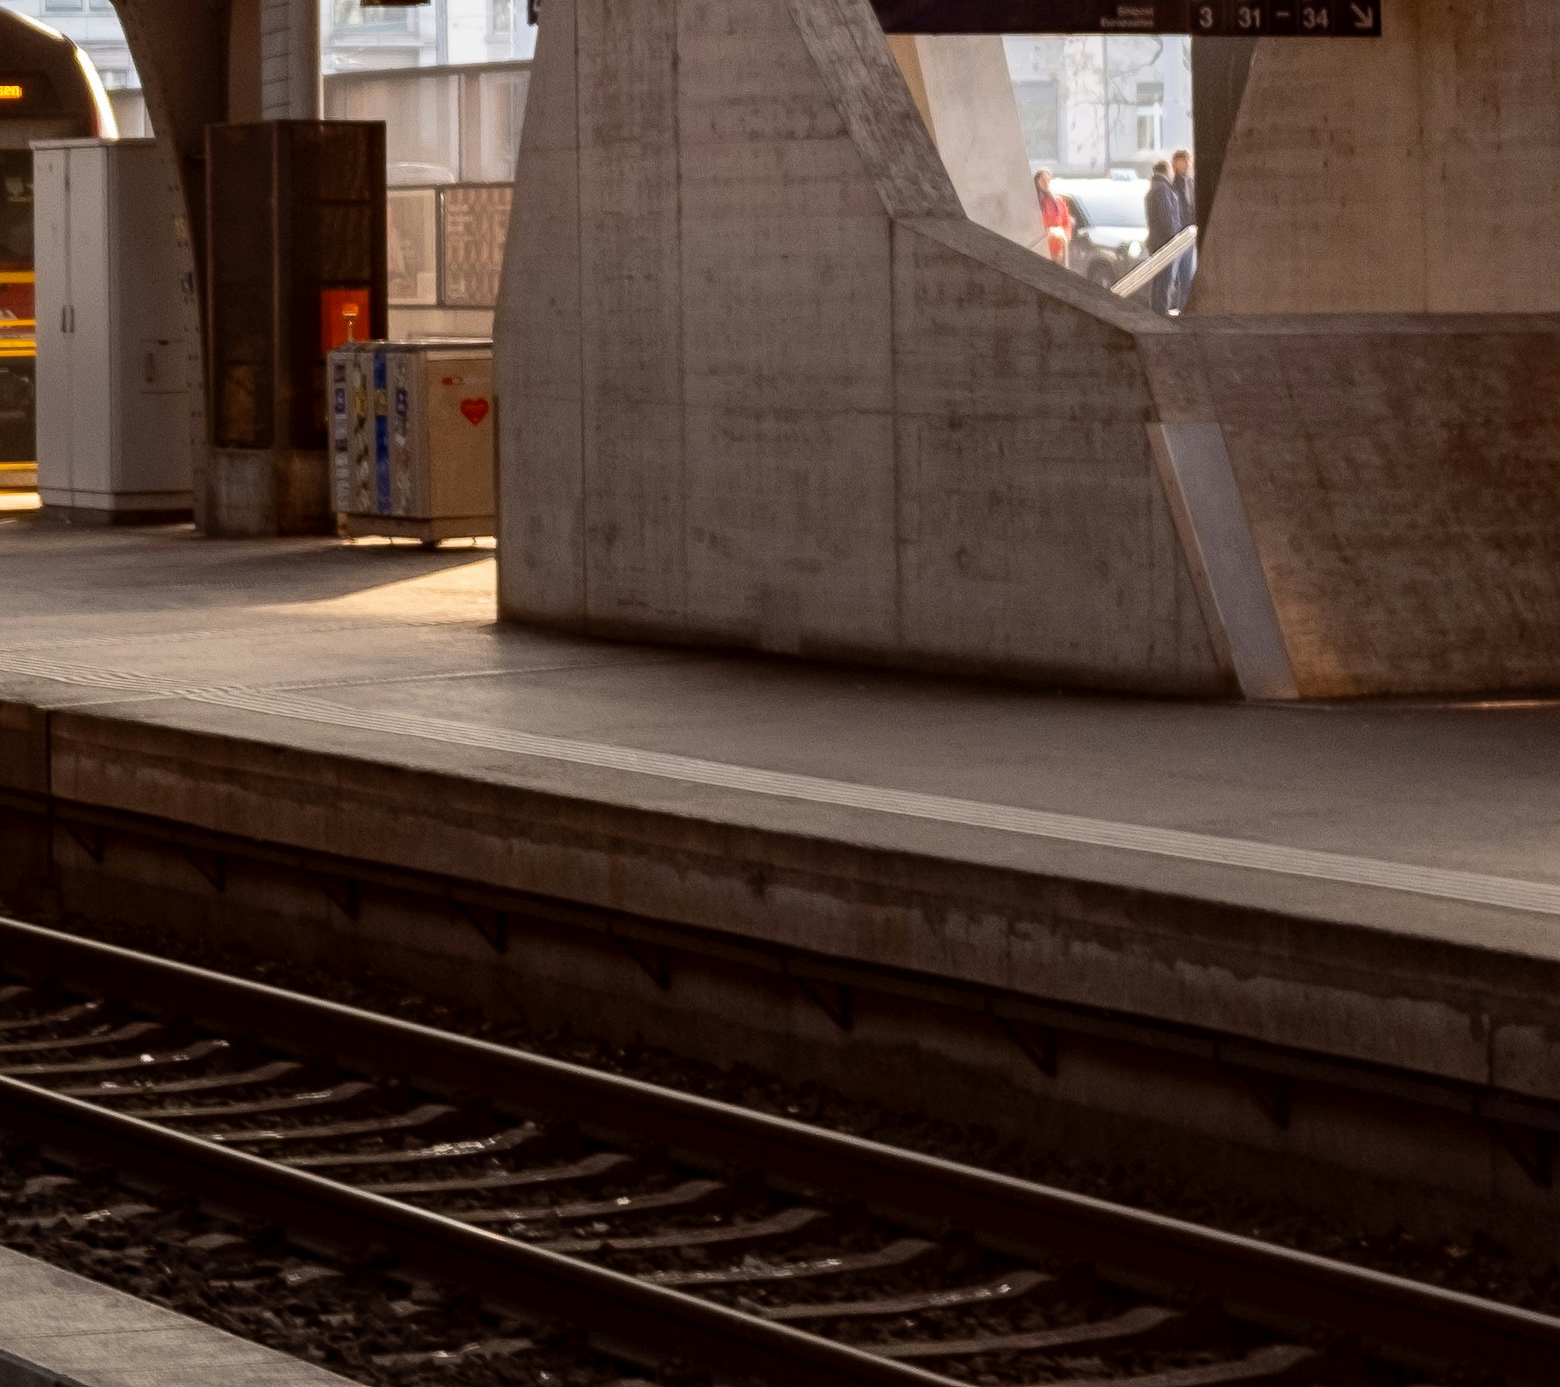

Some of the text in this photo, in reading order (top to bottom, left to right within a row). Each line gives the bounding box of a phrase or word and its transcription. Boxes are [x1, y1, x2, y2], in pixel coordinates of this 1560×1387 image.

[1199, 6, 1213, 28] 3
[1238, 6, 1261, 28] 31
[1302, 6, 1329, 28] 34
